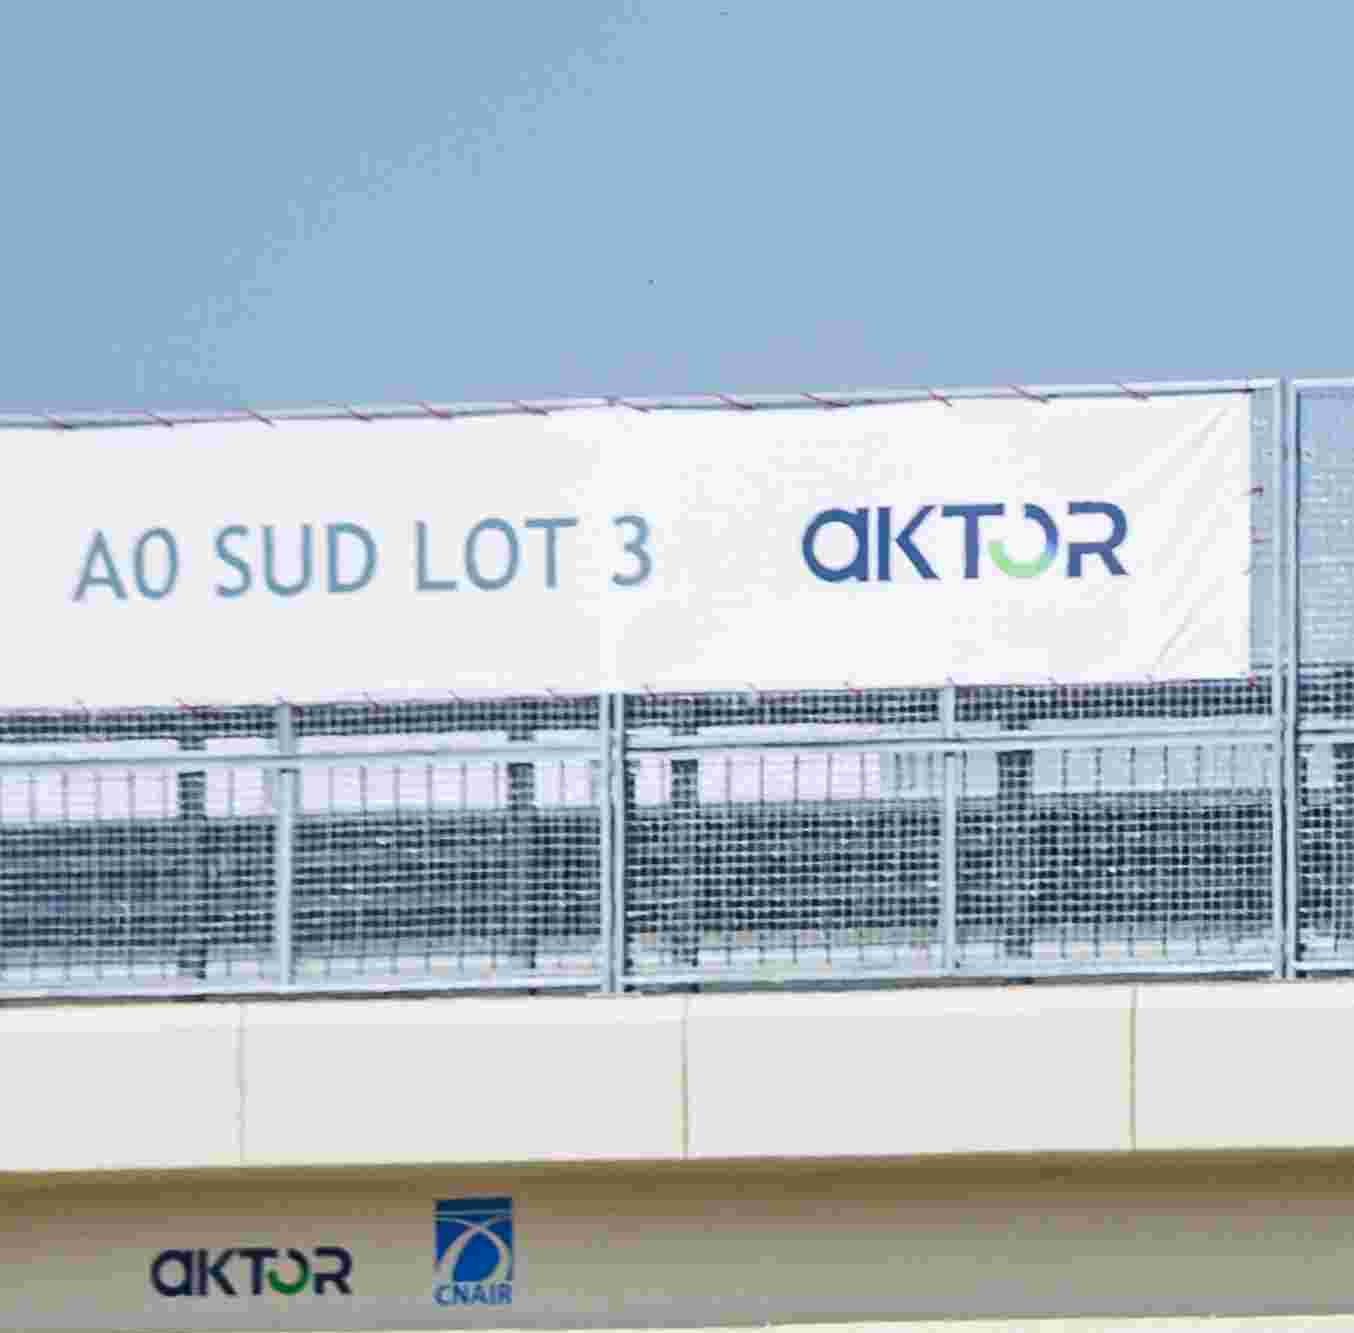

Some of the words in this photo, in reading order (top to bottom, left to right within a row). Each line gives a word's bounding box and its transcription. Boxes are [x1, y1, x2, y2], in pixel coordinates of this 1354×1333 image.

[214, 522, 378, 598] SUD
[414, 516, 579, 592] LOT
[611, 513, 653, 587] 3
[432, 1282, 513, 1306] CNAIR
